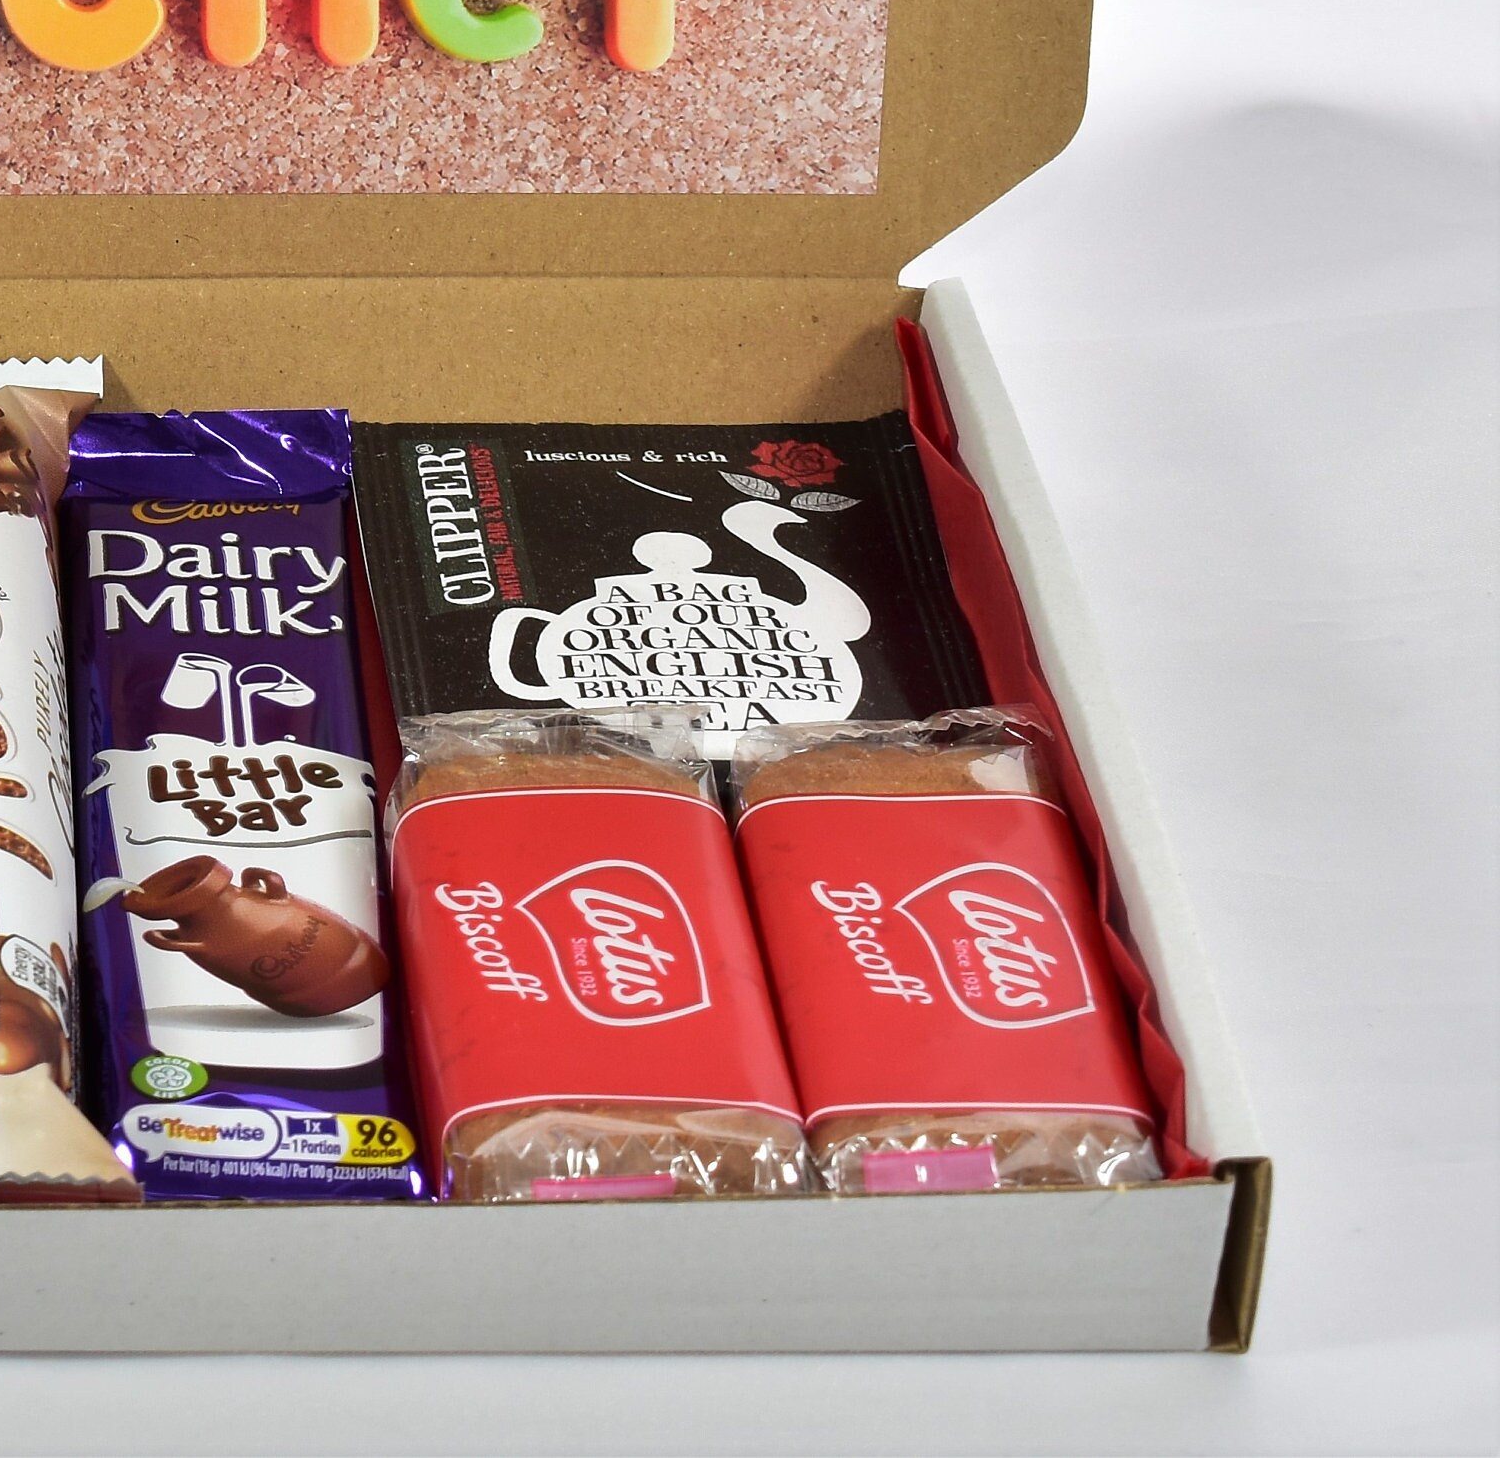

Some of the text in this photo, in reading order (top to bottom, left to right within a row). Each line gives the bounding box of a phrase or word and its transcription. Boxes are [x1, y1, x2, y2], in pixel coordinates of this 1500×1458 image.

[524, 450, 728, 463] luscious & rich
[417, 447, 495, 605] CLIPPER
[87, 529, 347, 594] Dairy
[103, 583, 343, 635] Milk
[601, 583, 753, 603] A BAG
[586, 604, 789, 629] OF OUR
[562, 626, 818, 652] ORGANIC
[557, 651, 841, 683] ENGLISH
[33, 650, 52, 753] PURELY
[575, 679, 844, 703] BREAKFAST
[627, 700, 781, 731] EA
[147, 754, 343, 803] Little
[183, 793, 312, 837] Bar
[435, 881, 548, 1001] Biscoff
[570, 888, 675, 1005] Lotus
[810, 880, 933, 1005] Biscoff
[948, 889, 1057, 1008] Lotus
[571, 937, 597, 996] Since 1932
[952, 938, 982, 998] Since 1932
[301, 1139, 342, 1155] Portion
[303, 1119, 322, 1133] 1x
[357, 1119, 397, 1146] 96
[351, 1146, 403, 1158] calories
